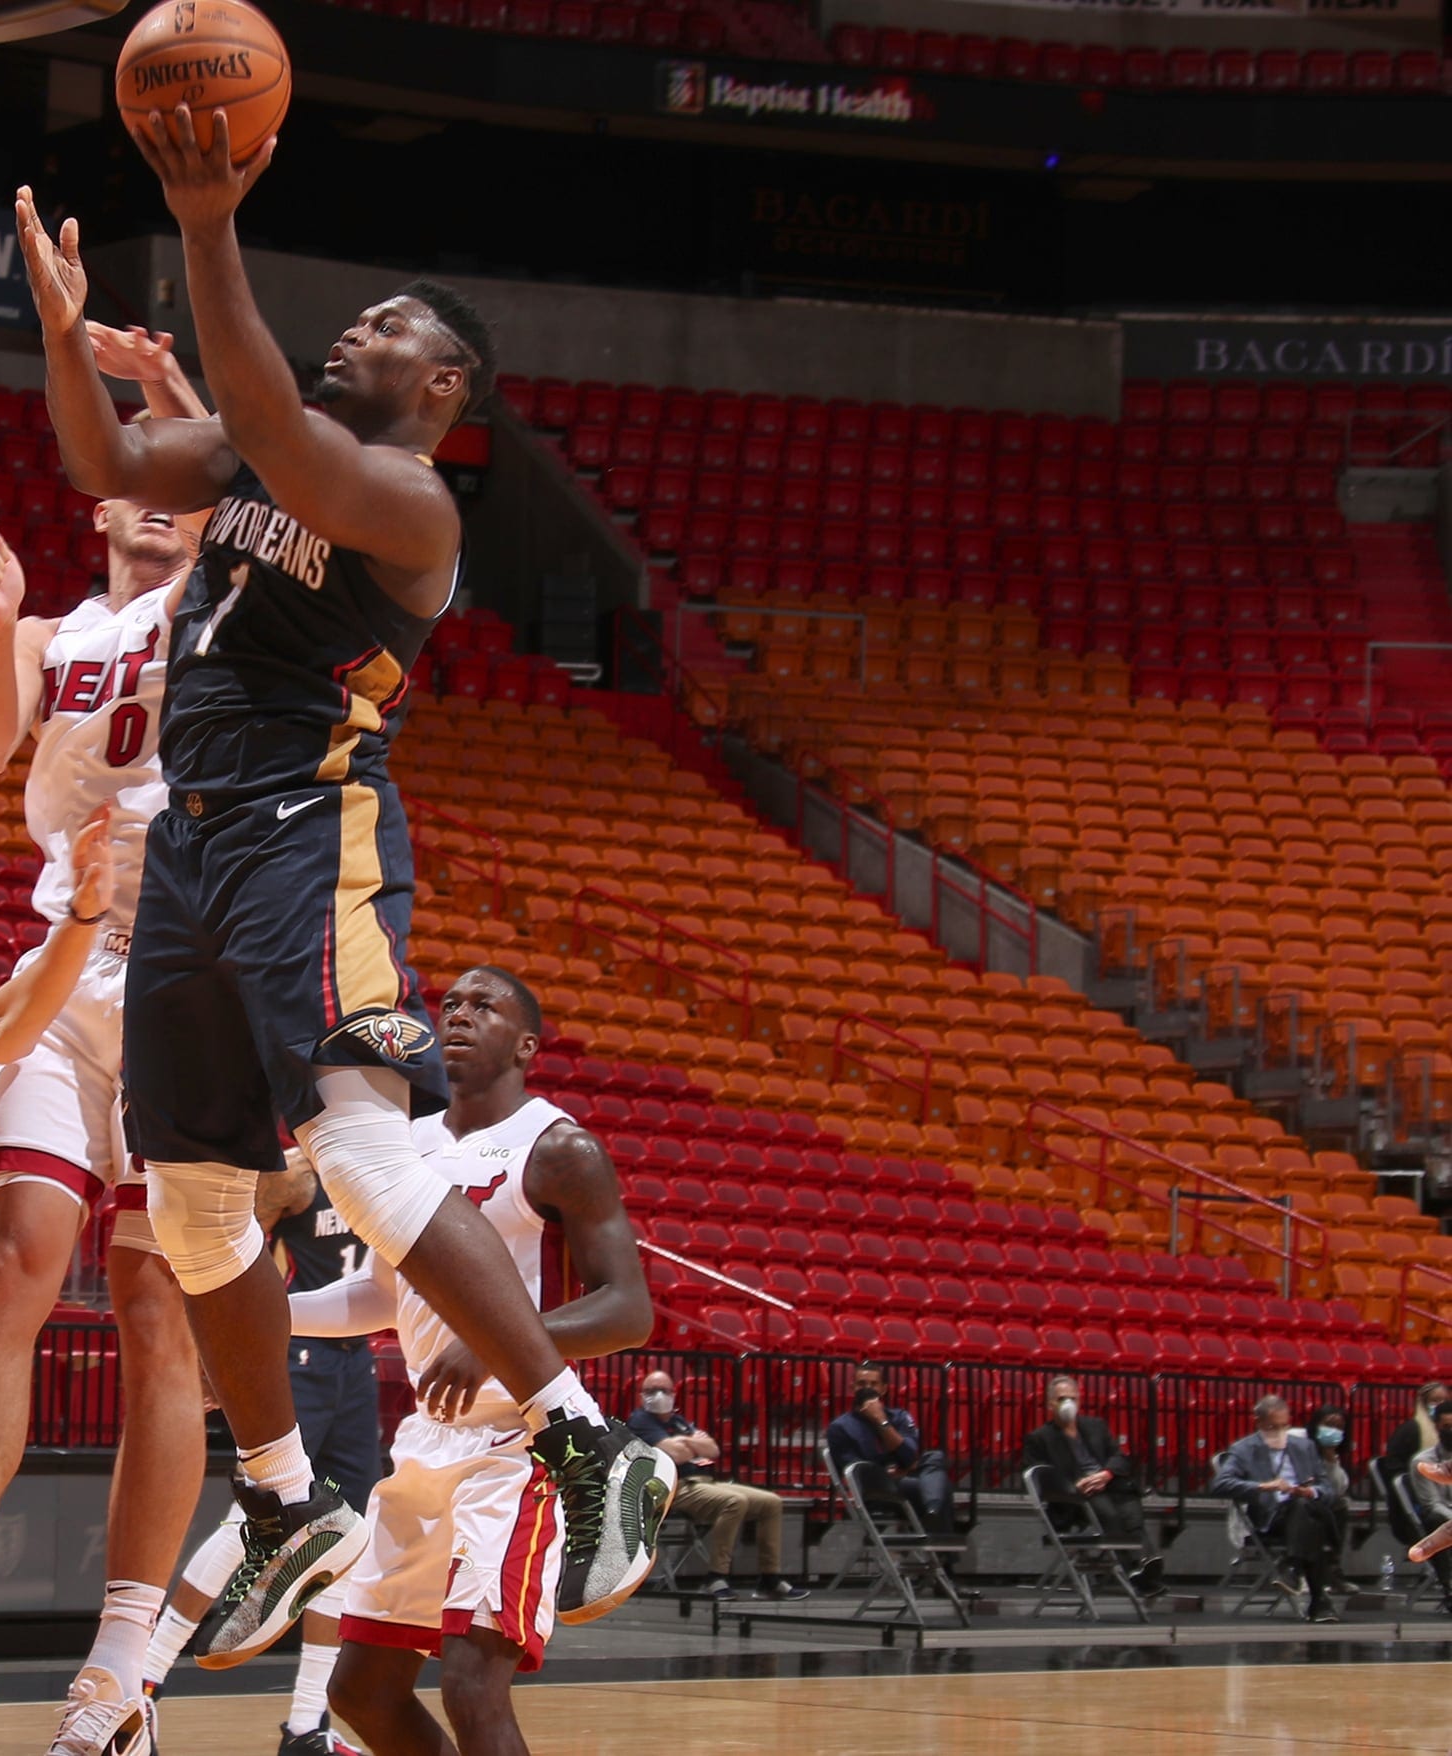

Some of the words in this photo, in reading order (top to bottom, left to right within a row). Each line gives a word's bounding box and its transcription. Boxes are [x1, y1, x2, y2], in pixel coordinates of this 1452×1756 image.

[134, 52, 252, 97] SPALDING
[709, 75, 810, 117] Baptist
[815, 83, 914, 122] Health
[194, 560, 252, 657] 1
[105, 702, 149, 768] 0
[478, 1147, 510, 1159] UKG
